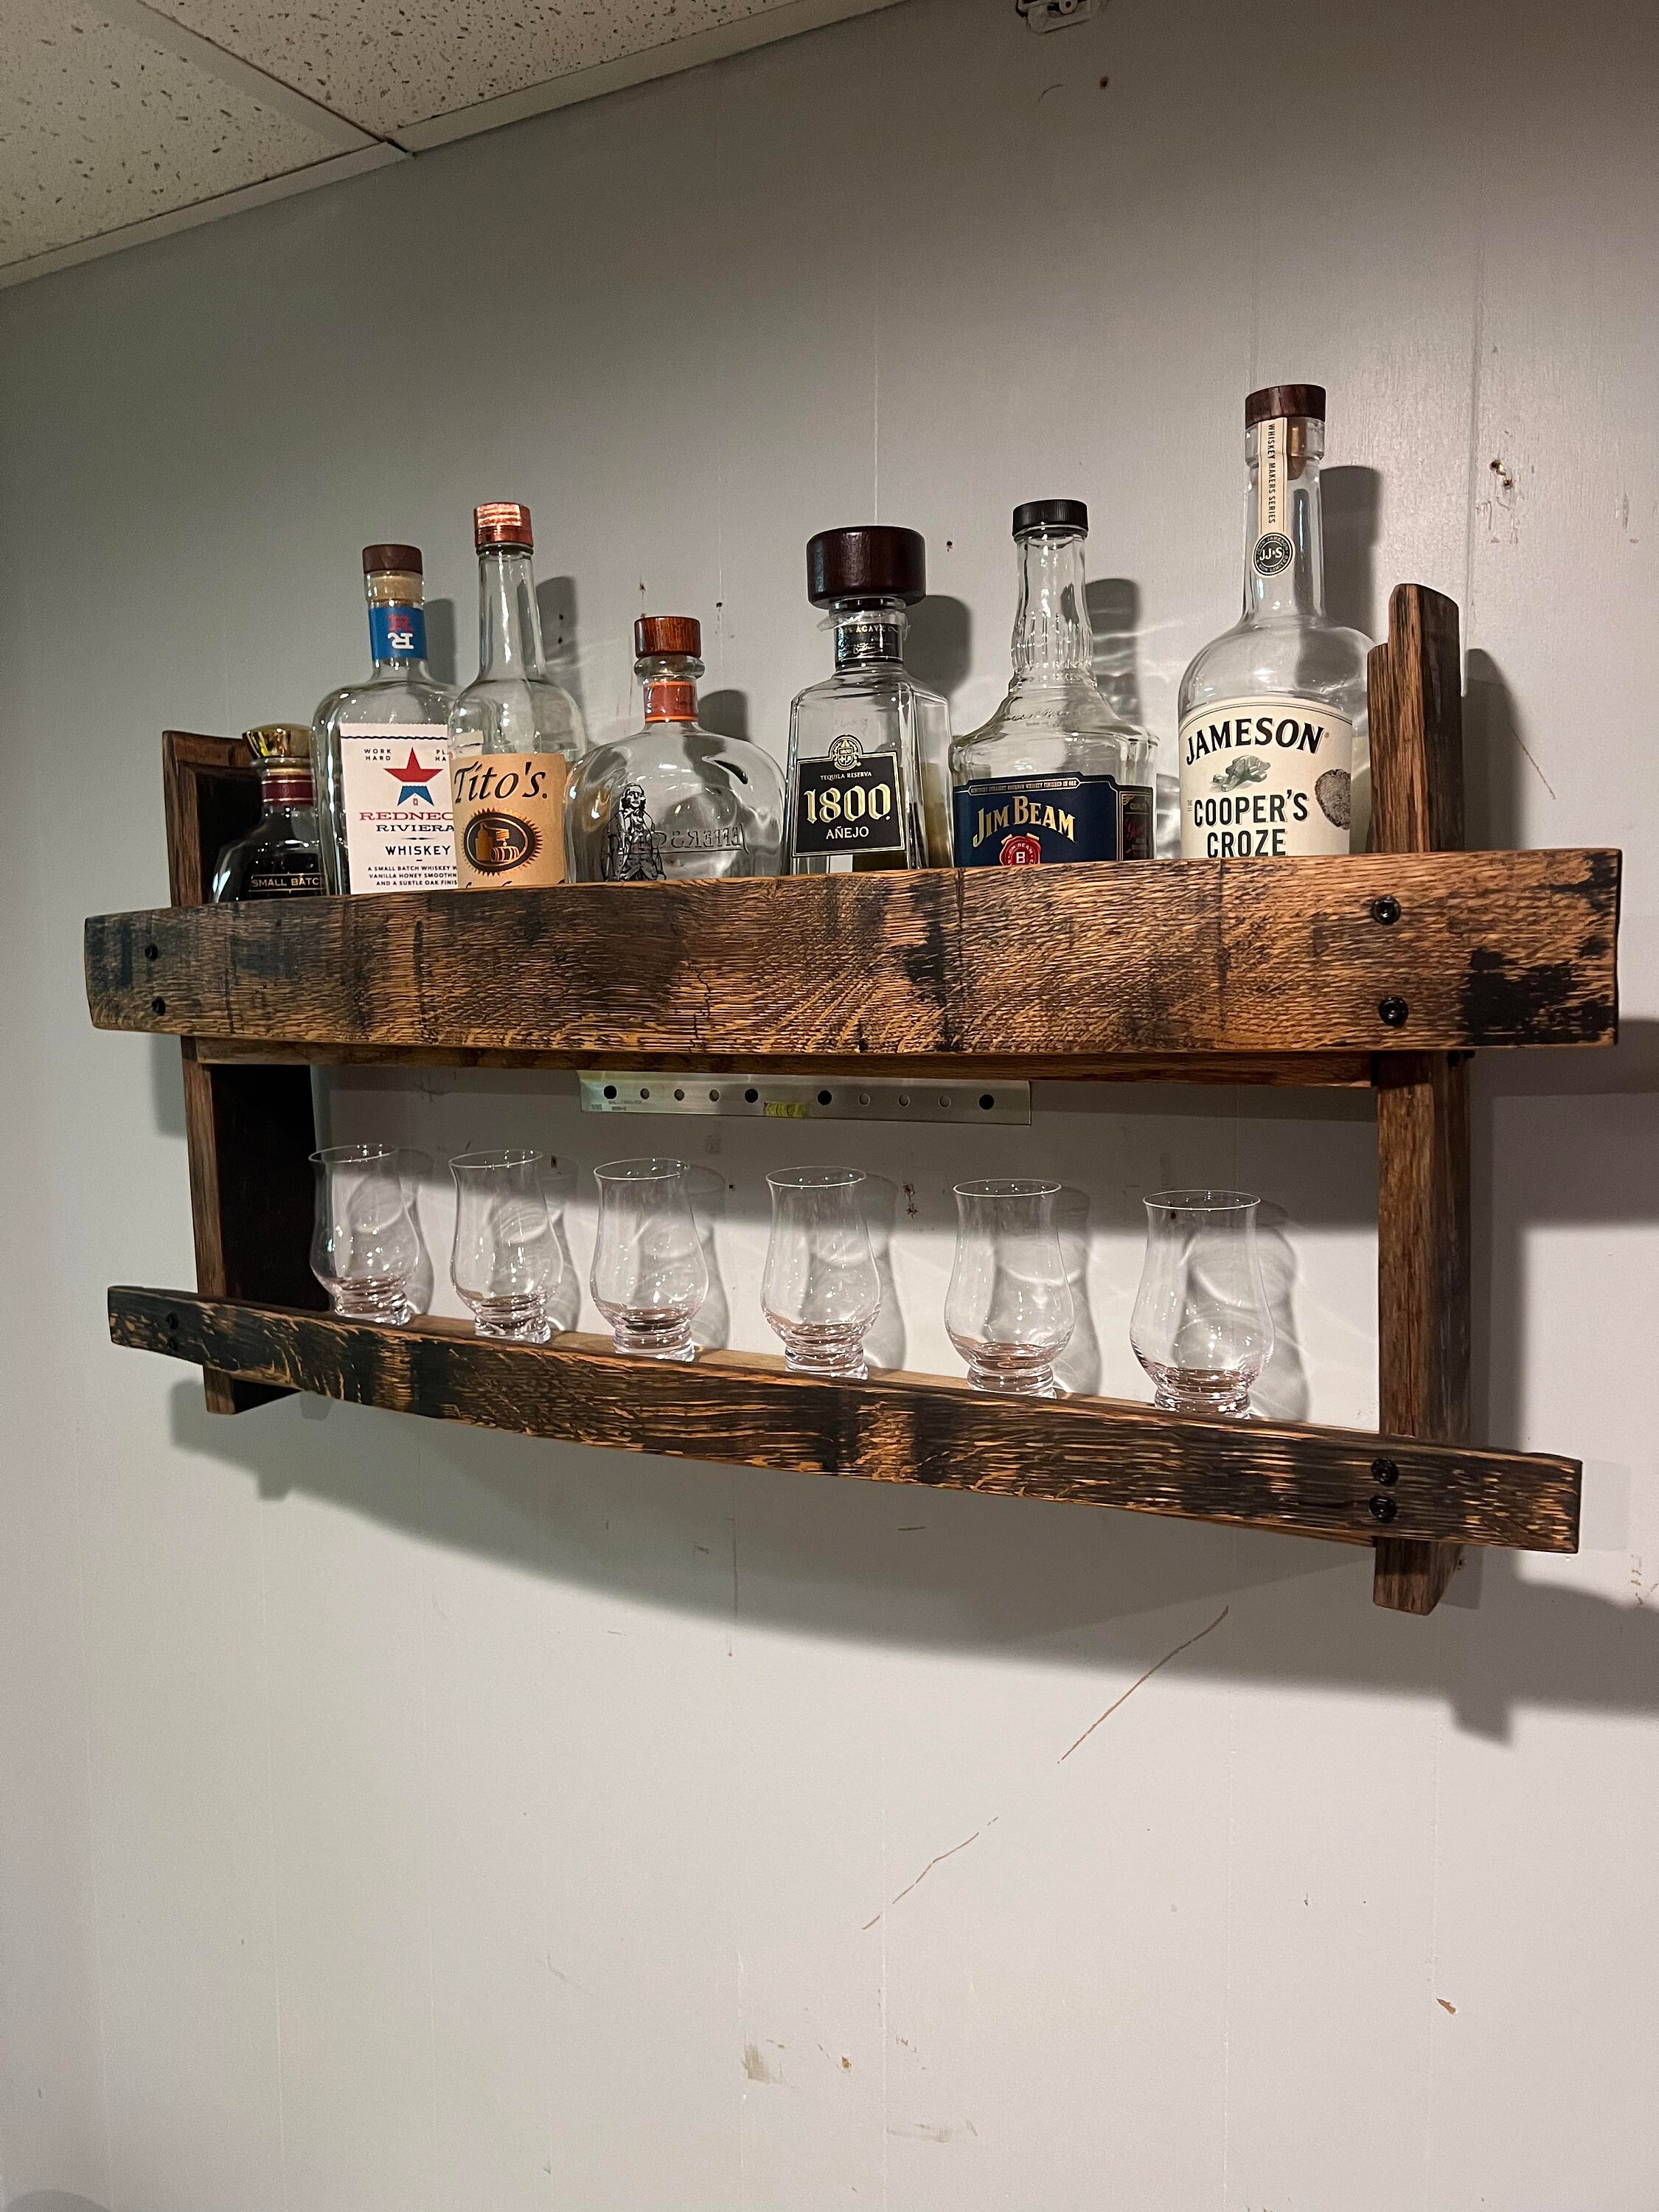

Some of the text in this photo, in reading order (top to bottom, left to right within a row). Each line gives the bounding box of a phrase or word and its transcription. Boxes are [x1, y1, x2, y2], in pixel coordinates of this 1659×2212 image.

[1267, 423, 1276, 459] WHISKEY
[1268, 463, 1276, 493] MAKERS
[388, 615, 413, 632] R
[1186, 717, 1324, 765] JAMESON
[359, 812, 454, 821] REDNEC
[803, 783, 891, 824] 1800
[1194, 789, 1309, 827] COOPER'S
[826, 826, 869, 840] AÑEJO
[973, 805, 1009, 848] JIM
[1012, 796, 1076, 843] BEAM
[385, 845, 451, 855] WHISKEY
[1016, 852, 1026, 863] B
[1207, 829, 1286, 858] CROZE
[252, 877, 319, 886] SMALL BATC
